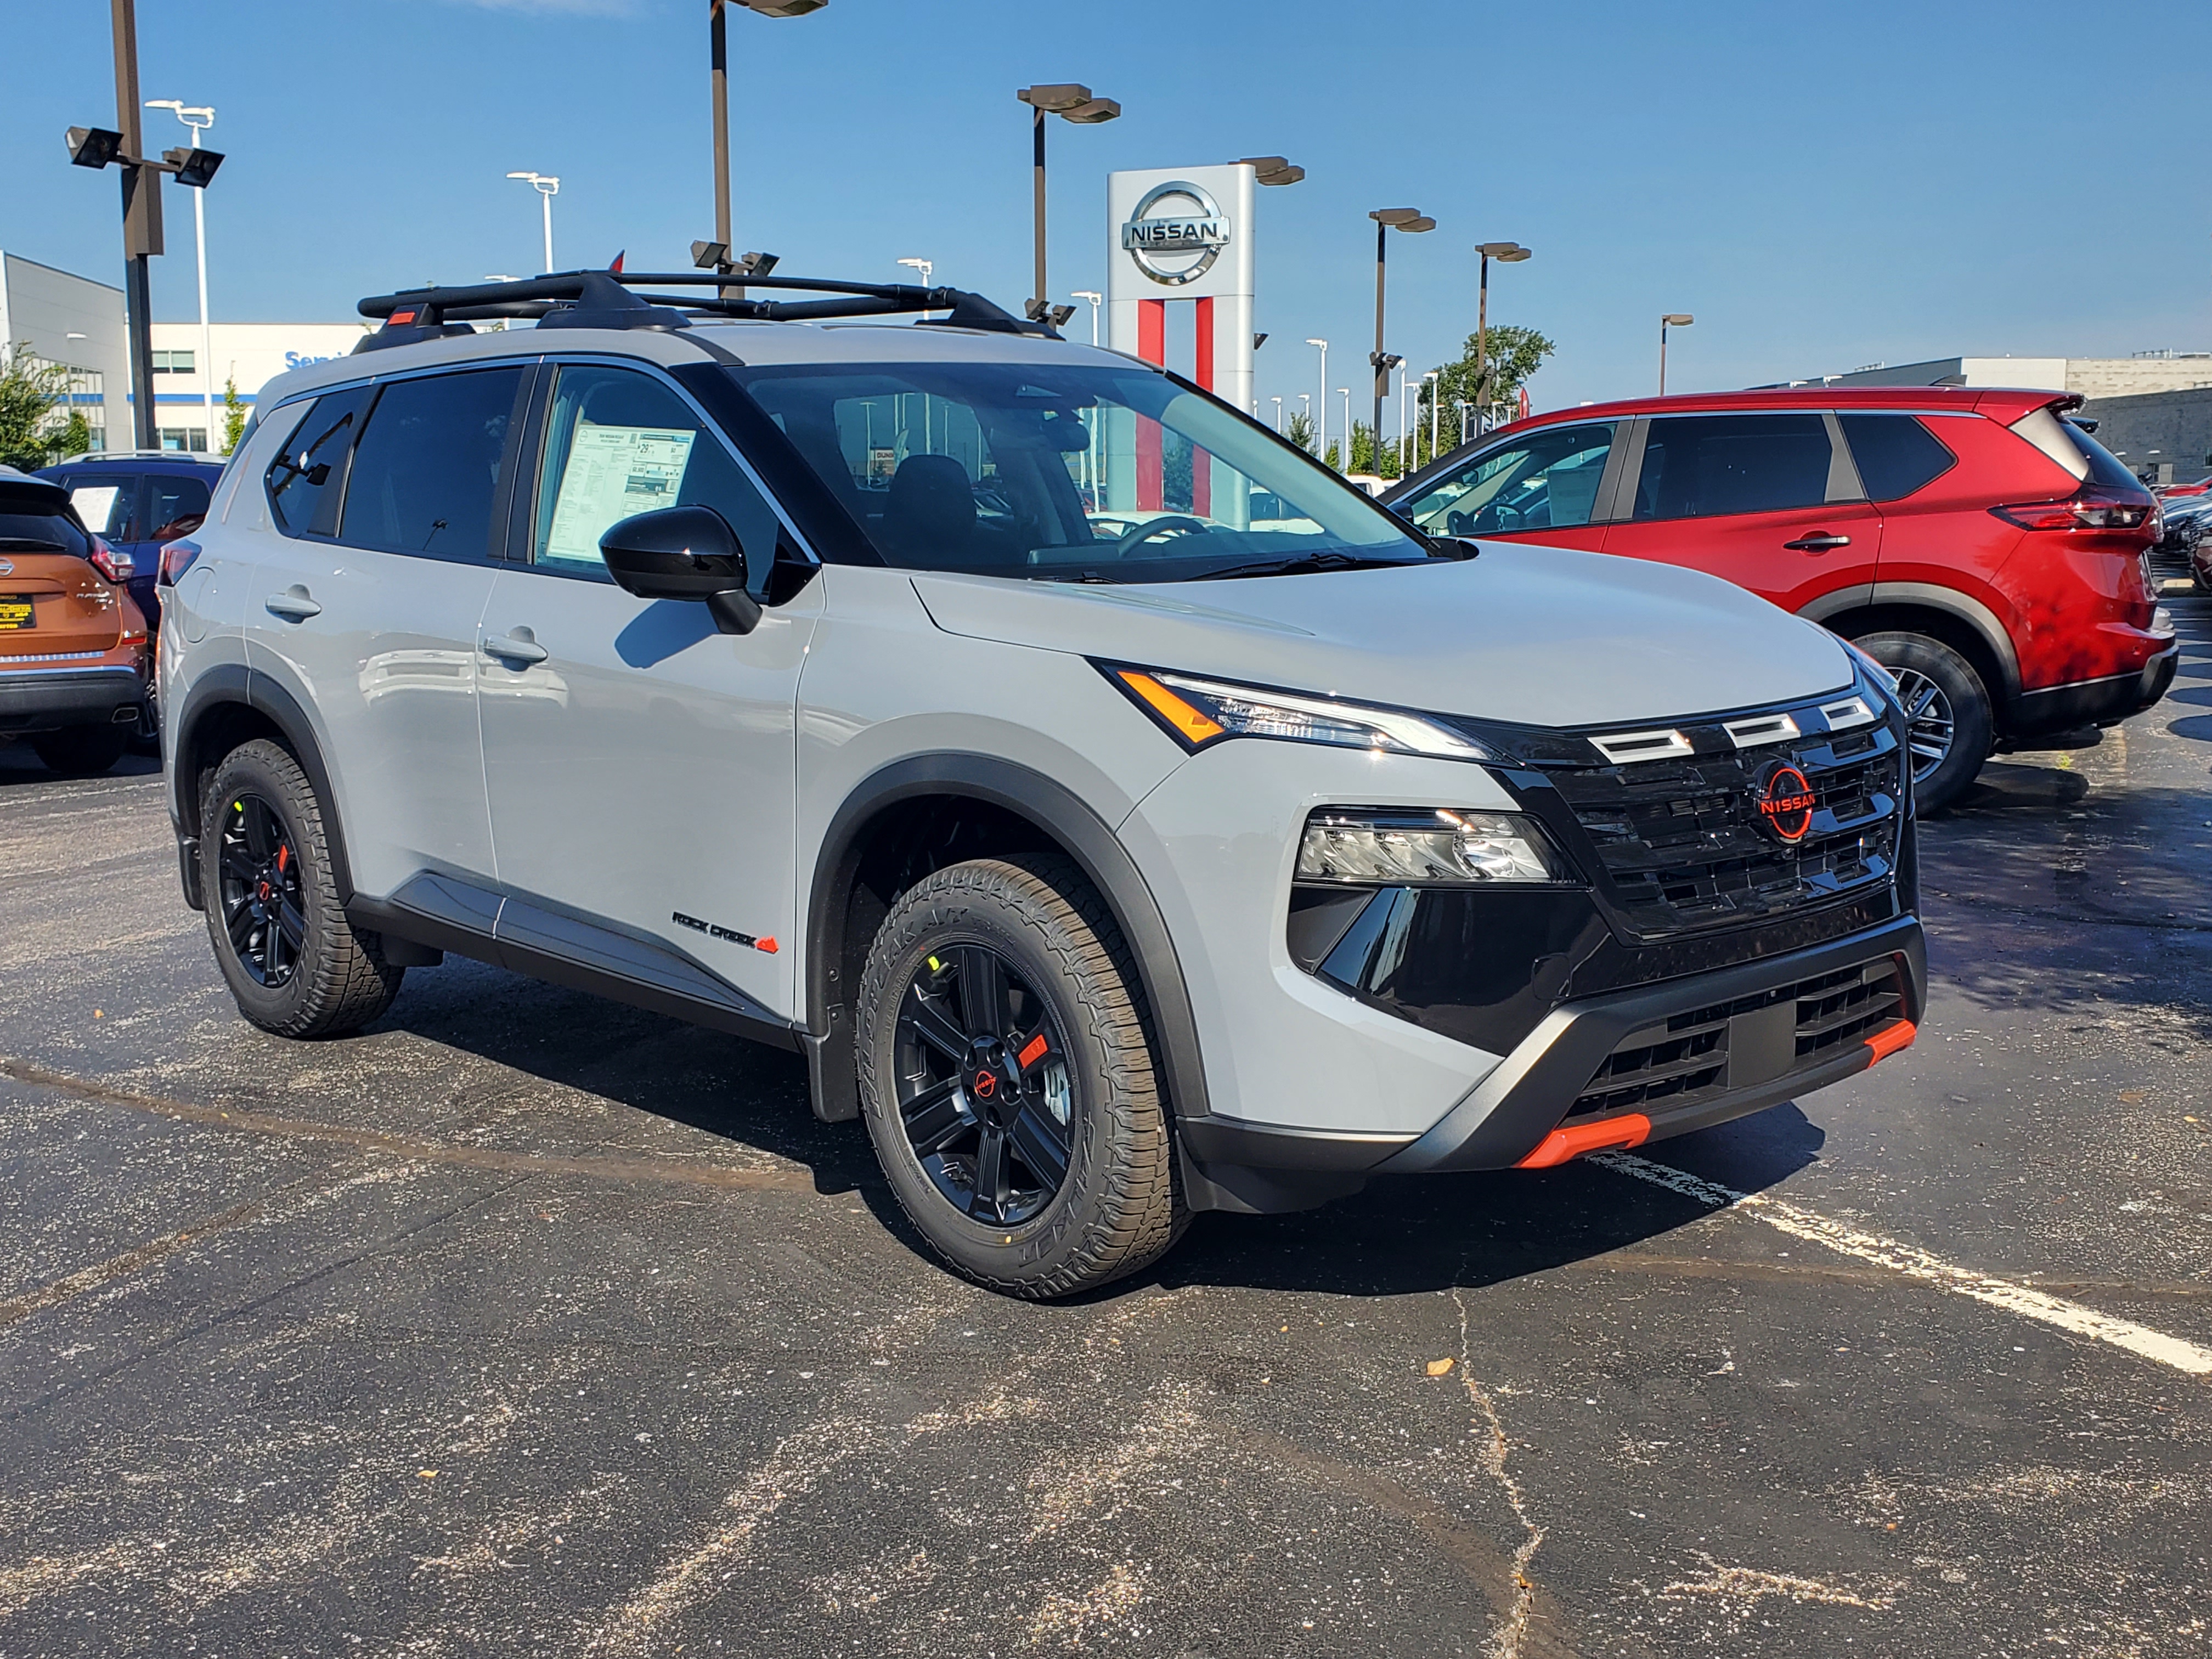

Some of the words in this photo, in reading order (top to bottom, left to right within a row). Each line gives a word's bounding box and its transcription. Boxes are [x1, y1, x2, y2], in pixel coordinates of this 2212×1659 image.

[1131, 223, 1217, 242] NISSAN
[1760, 793, 1816, 814] NISSAN
[672, 911, 709, 934] ROCK
[710, 924, 757, 949] CREEK
